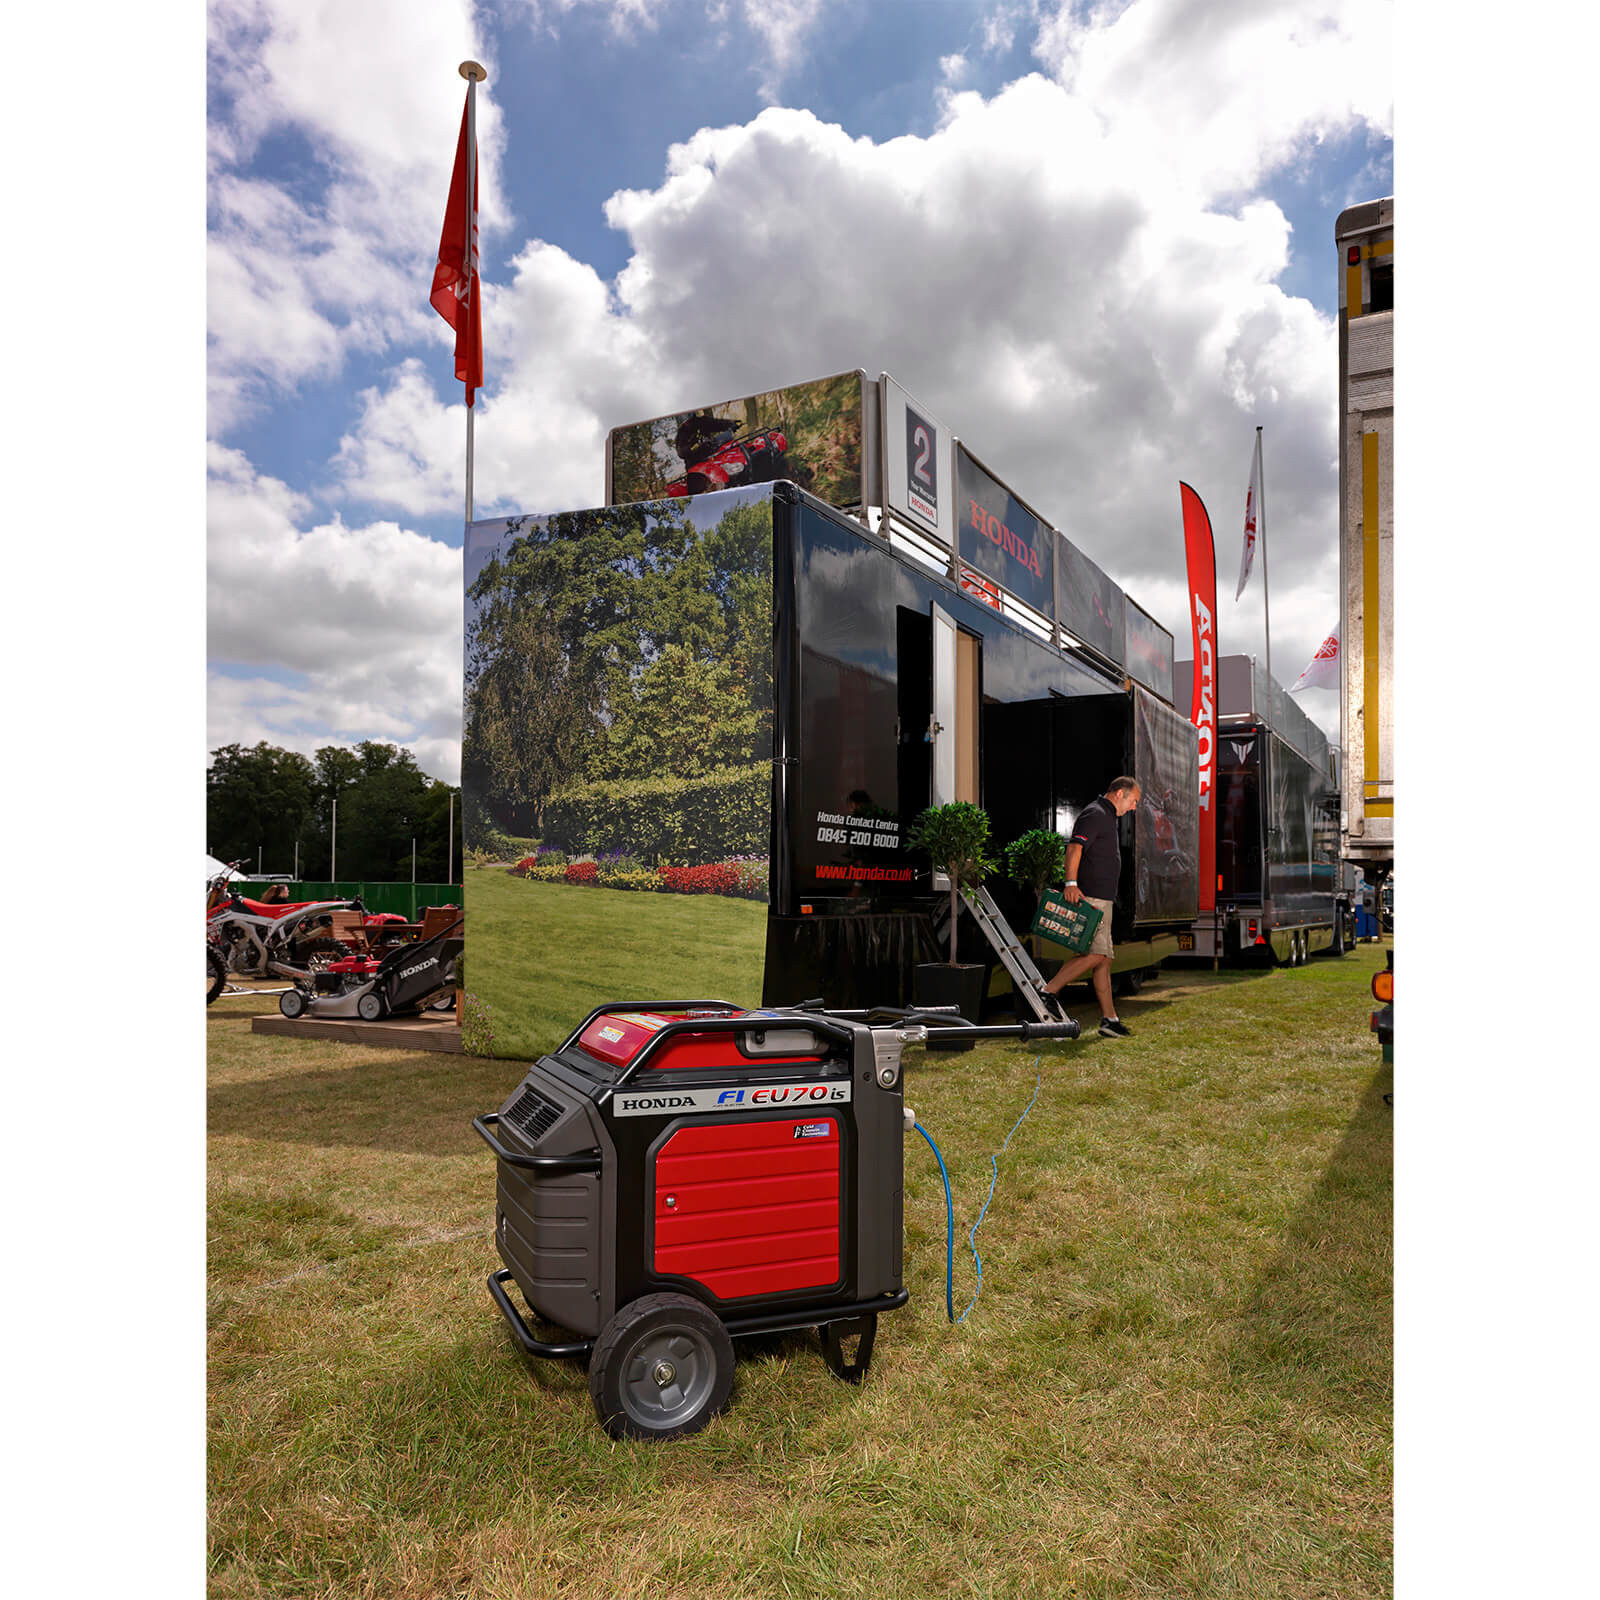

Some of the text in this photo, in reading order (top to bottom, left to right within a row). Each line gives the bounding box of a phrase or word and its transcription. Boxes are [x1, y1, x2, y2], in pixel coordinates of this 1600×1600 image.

[914, 424, 931, 487] 2
[911, 496, 934, 518] HONDA
[970, 499, 1042, 578] HONDA
[817, 811, 899, 831] Honda Contact Centre
[817, 827, 899, 848] 0845 200 8000
[815, 864, 912, 881] www.honda.co.uk
[399, 956, 439, 979] HONDA
[622, 1096, 696, 1111] HONDA
[717, 1090, 745, 1104] FI
